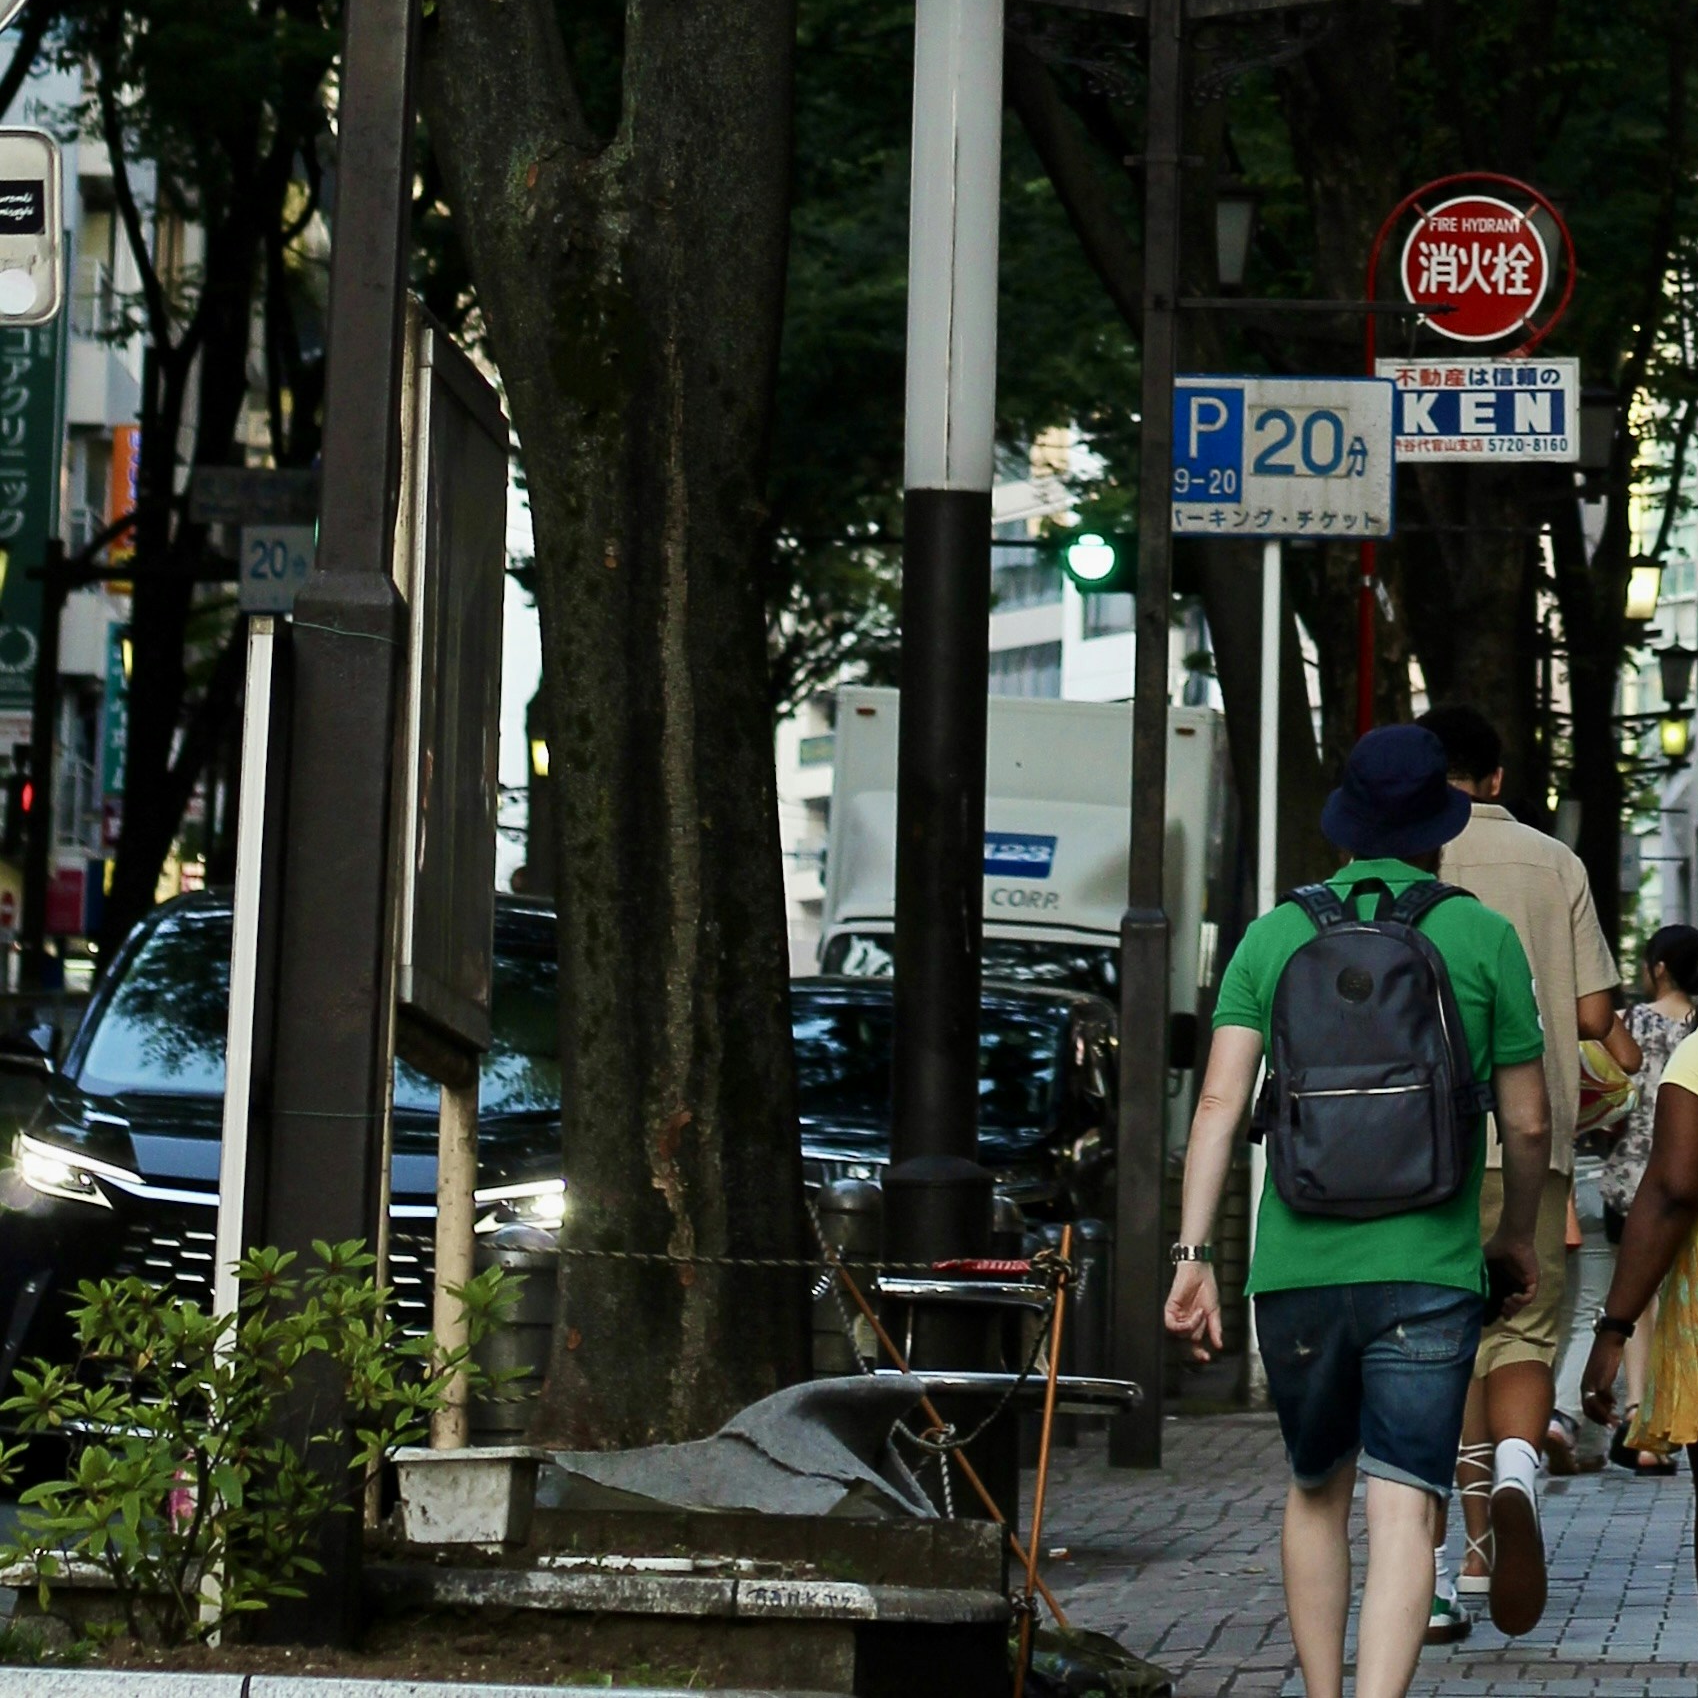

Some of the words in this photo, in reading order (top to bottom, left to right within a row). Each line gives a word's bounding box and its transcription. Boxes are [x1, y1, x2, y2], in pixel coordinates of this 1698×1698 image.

[1430, 216, 1458, 233] FIRE
[1461, 217, 1522, 234] HYDRANT
[1417, 241, 1535, 296] 消火栓
[1395, 367, 1561, 387] 不動産は信頼の
[1188, 395, 1229, 459] P
[1403, 391, 1552, 434] KEN
[1488, 437, 1568, 453] 5720-8160
